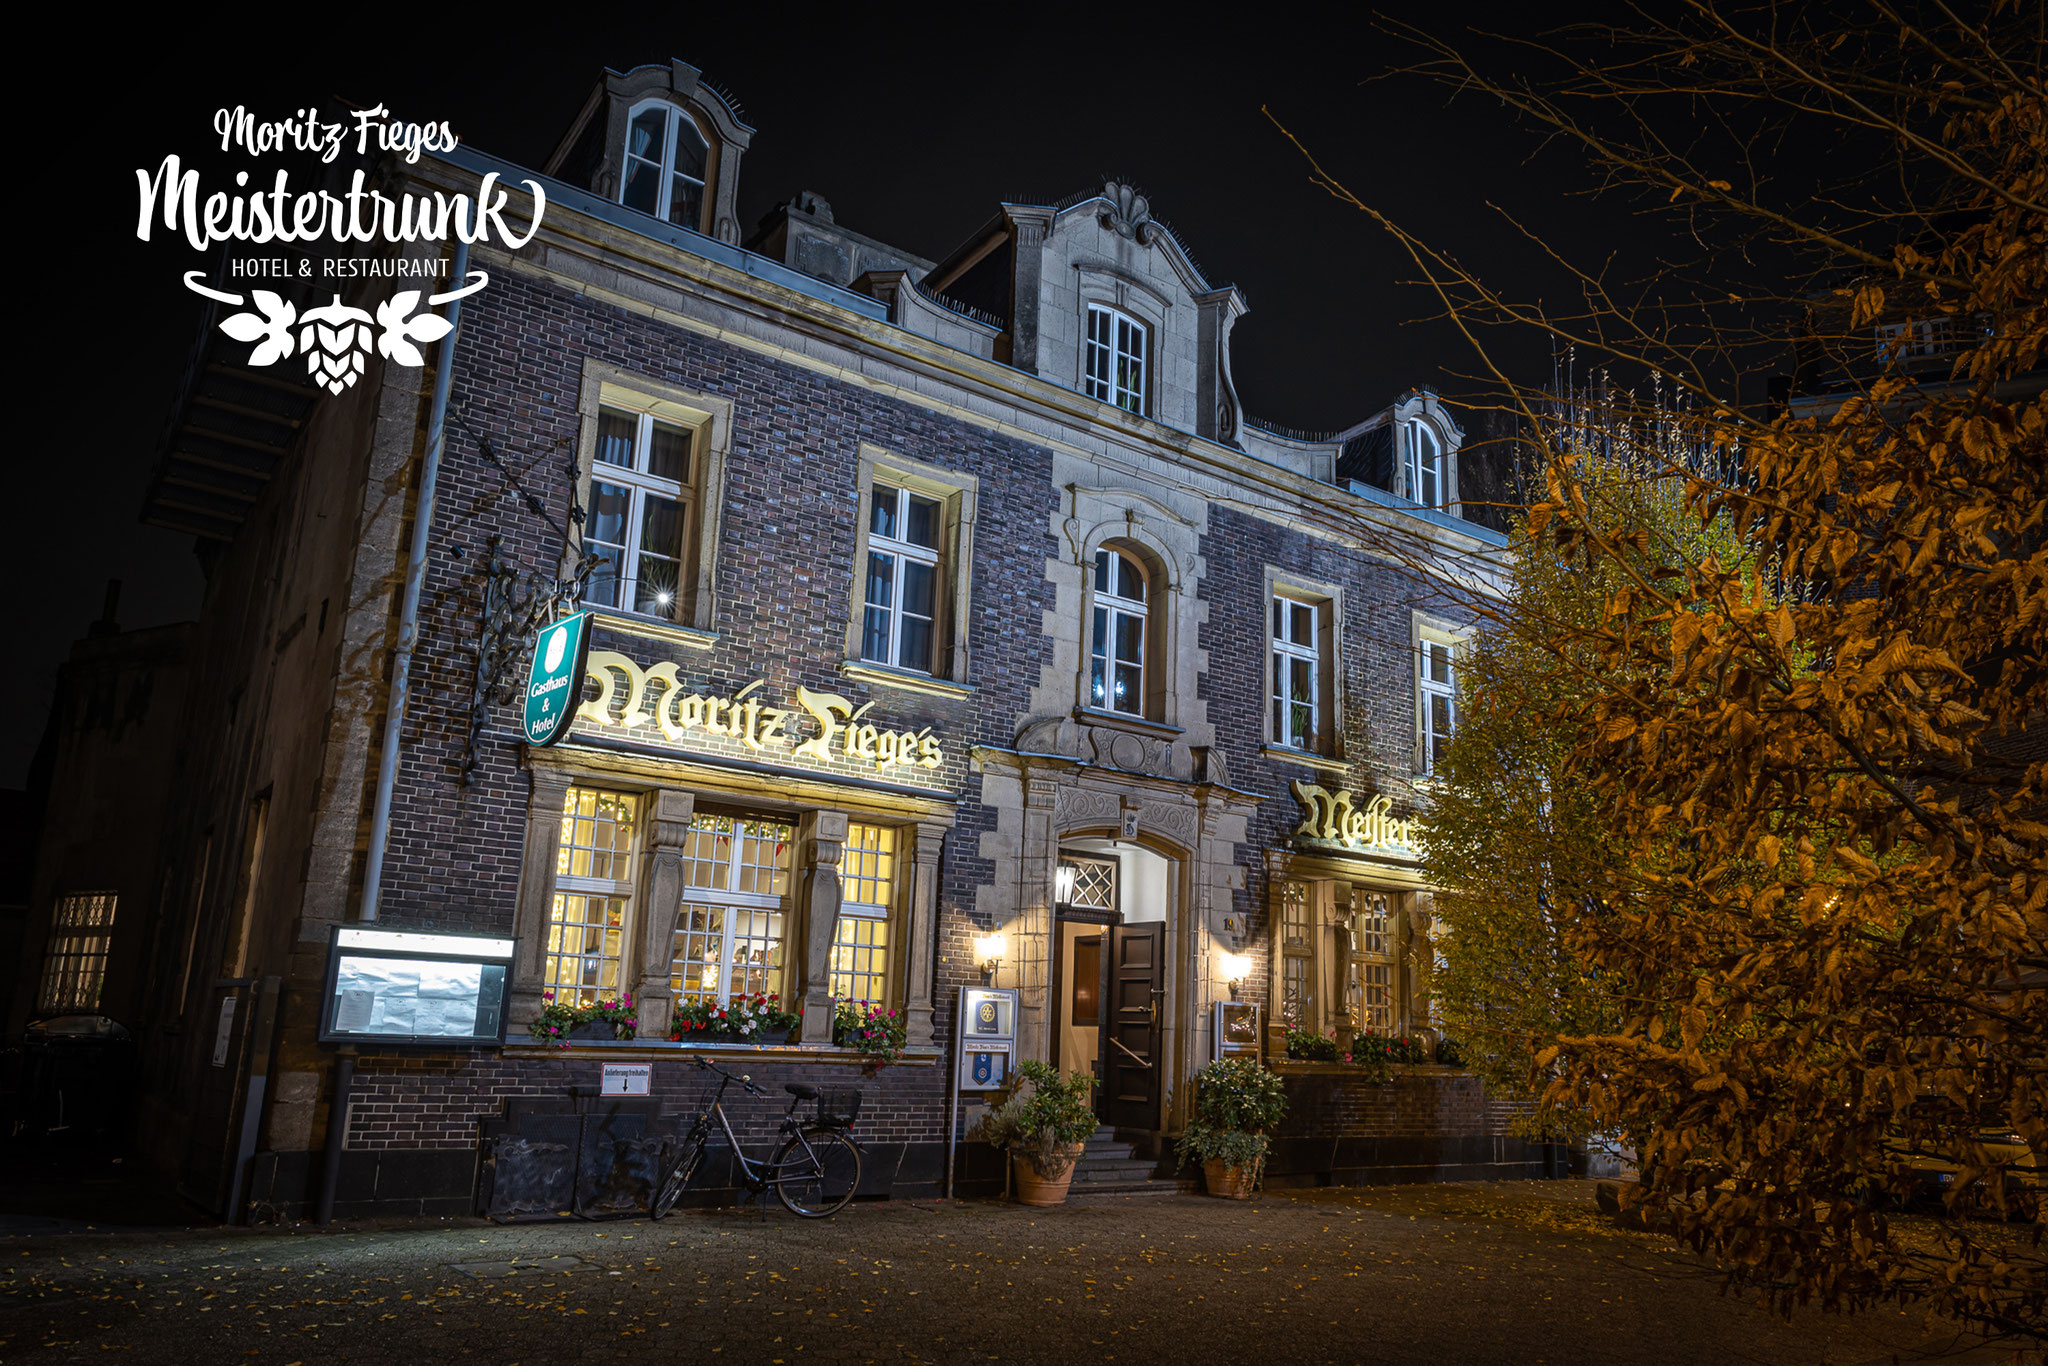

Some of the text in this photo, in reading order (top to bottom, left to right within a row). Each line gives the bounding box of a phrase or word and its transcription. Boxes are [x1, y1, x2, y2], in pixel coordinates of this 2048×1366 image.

[531, 675, 568, 698] Gasthaus
[542, 697, 551, 712] &
[576, 651, 787, 750] Moritz
[531, 713, 556, 735] Hotel
[1290, 779, 1422, 852] Meister
